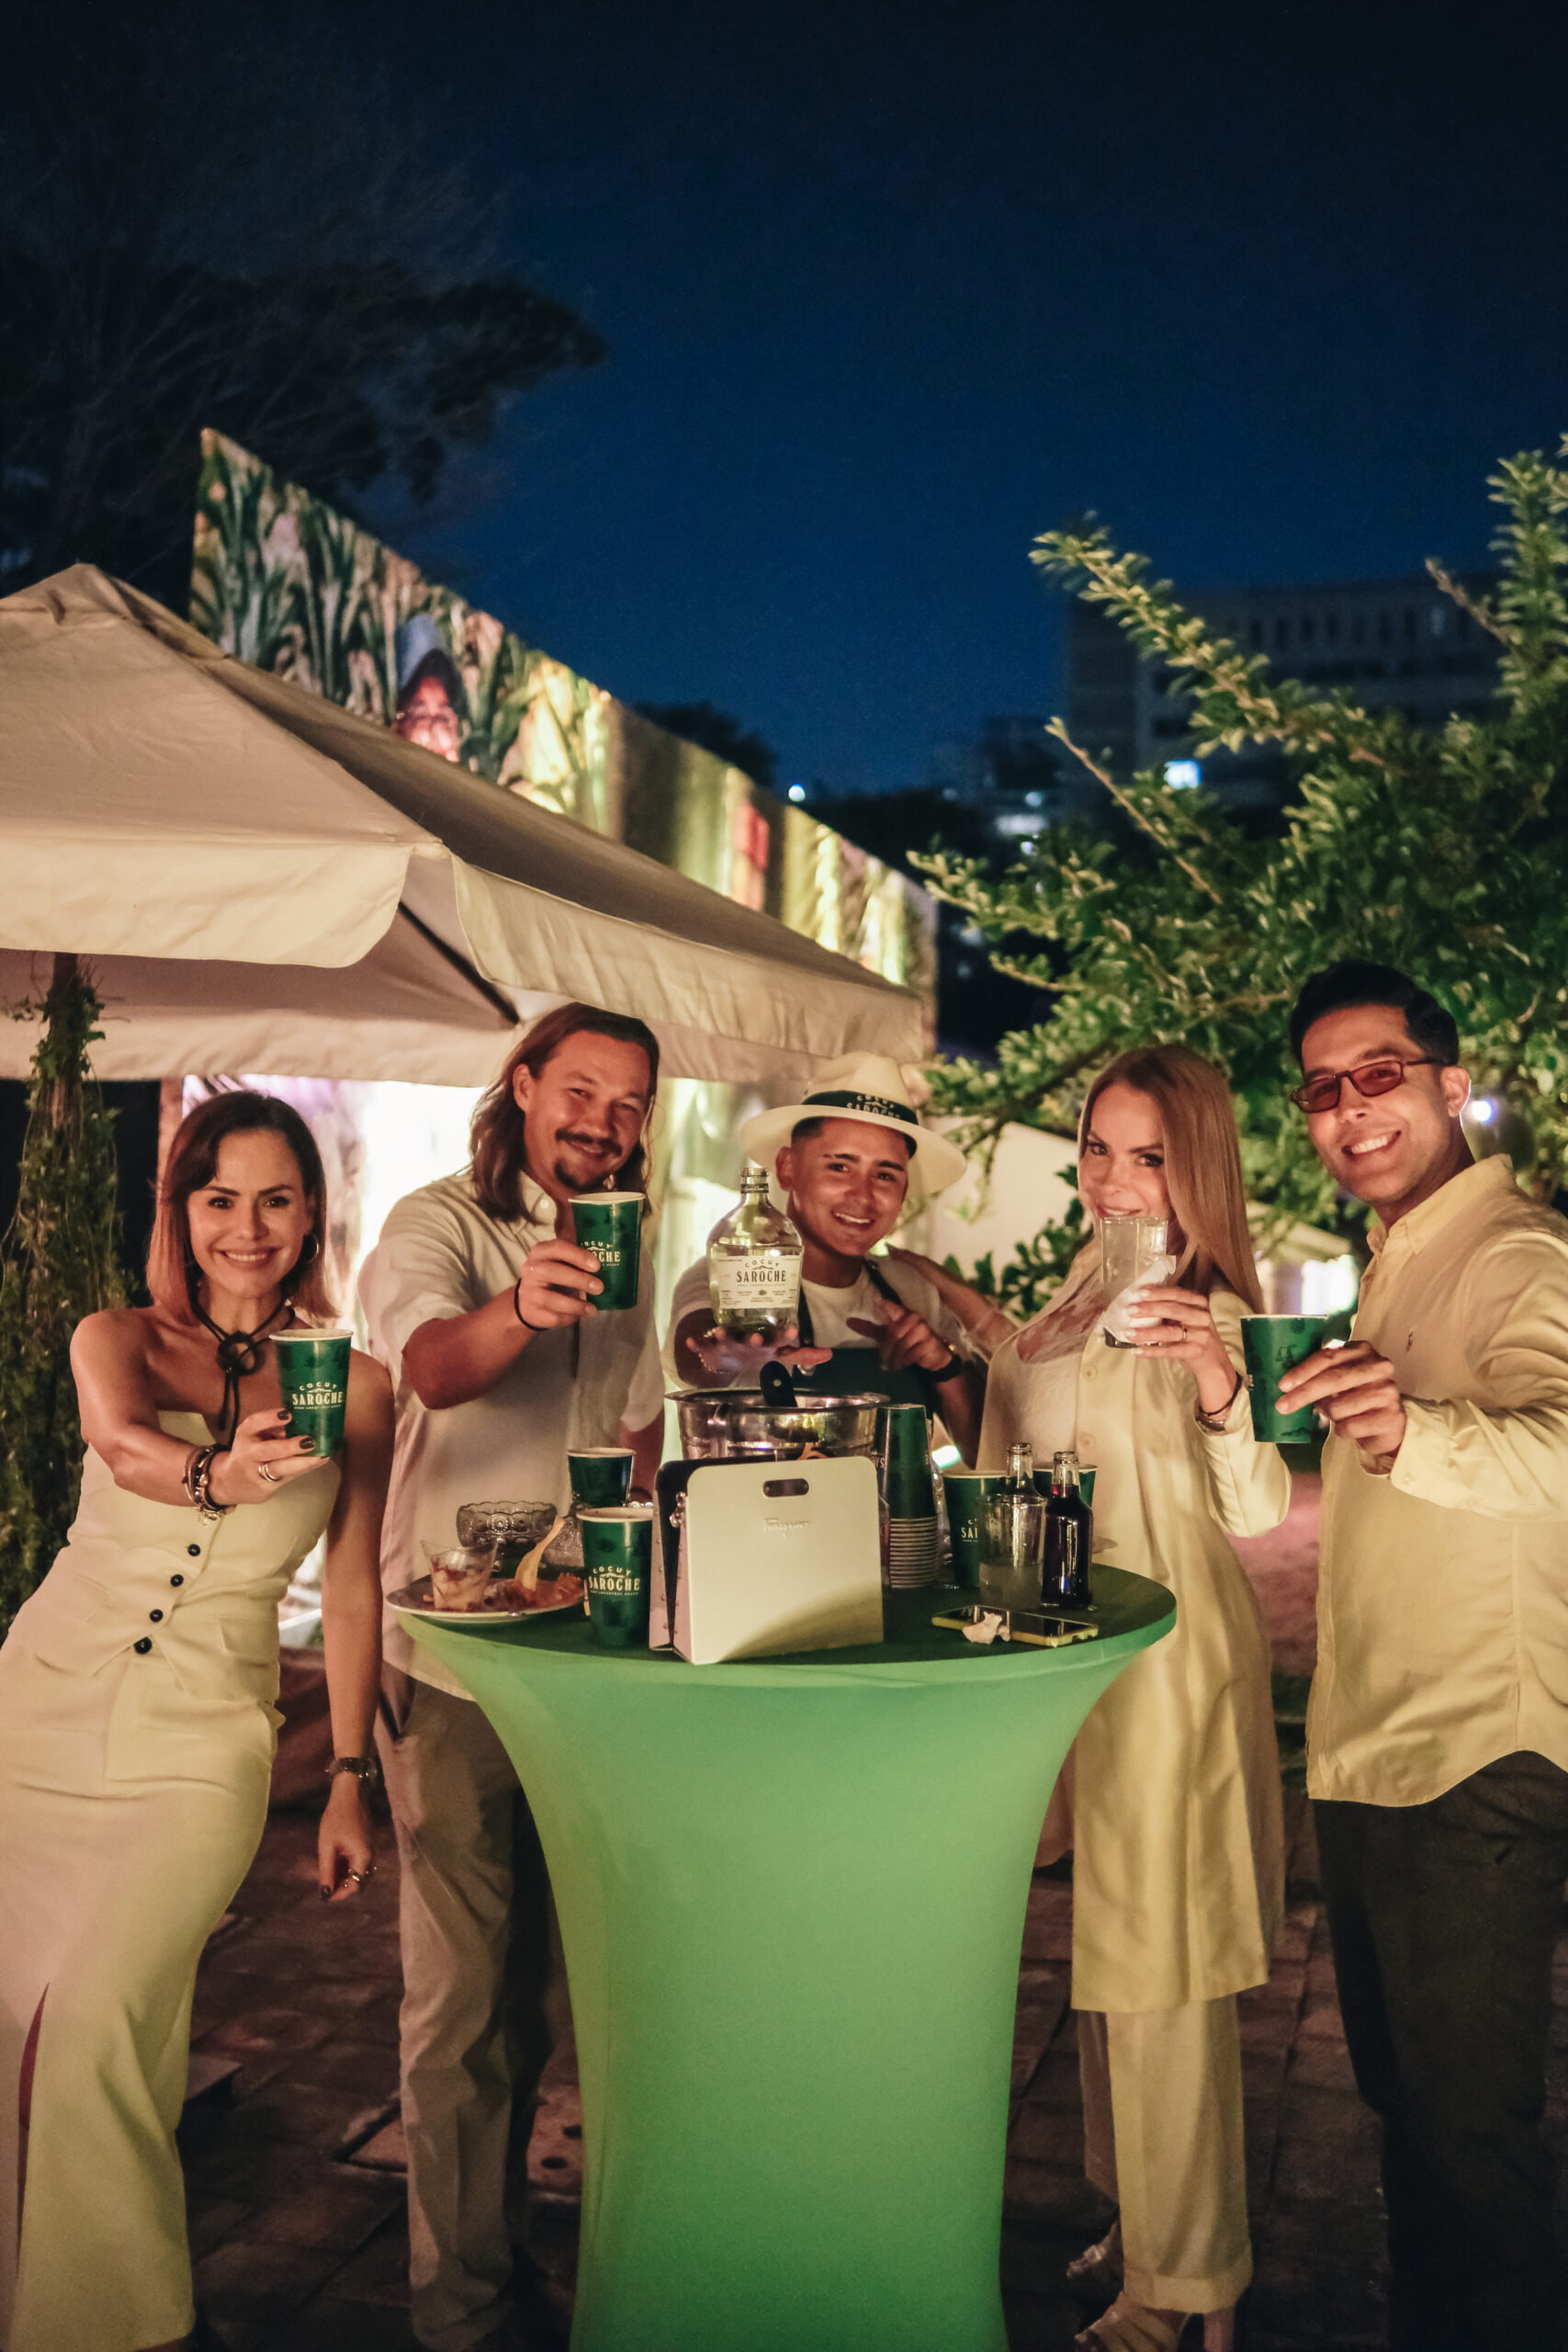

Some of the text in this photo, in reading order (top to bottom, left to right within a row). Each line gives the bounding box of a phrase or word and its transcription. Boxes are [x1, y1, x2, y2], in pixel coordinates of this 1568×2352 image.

[581, 1240, 614, 1250] OCUY
[744, 1259, 780, 1268] COCUY
[736, 1270, 786, 1283] SAROCHE
[299, 1381, 338, 1391] COCUY
[291, 1391, 344, 1406] SAROCHE
[592, 1565, 632, 1577] COCUY
[588, 1576, 640, 1591] SAROCHE
